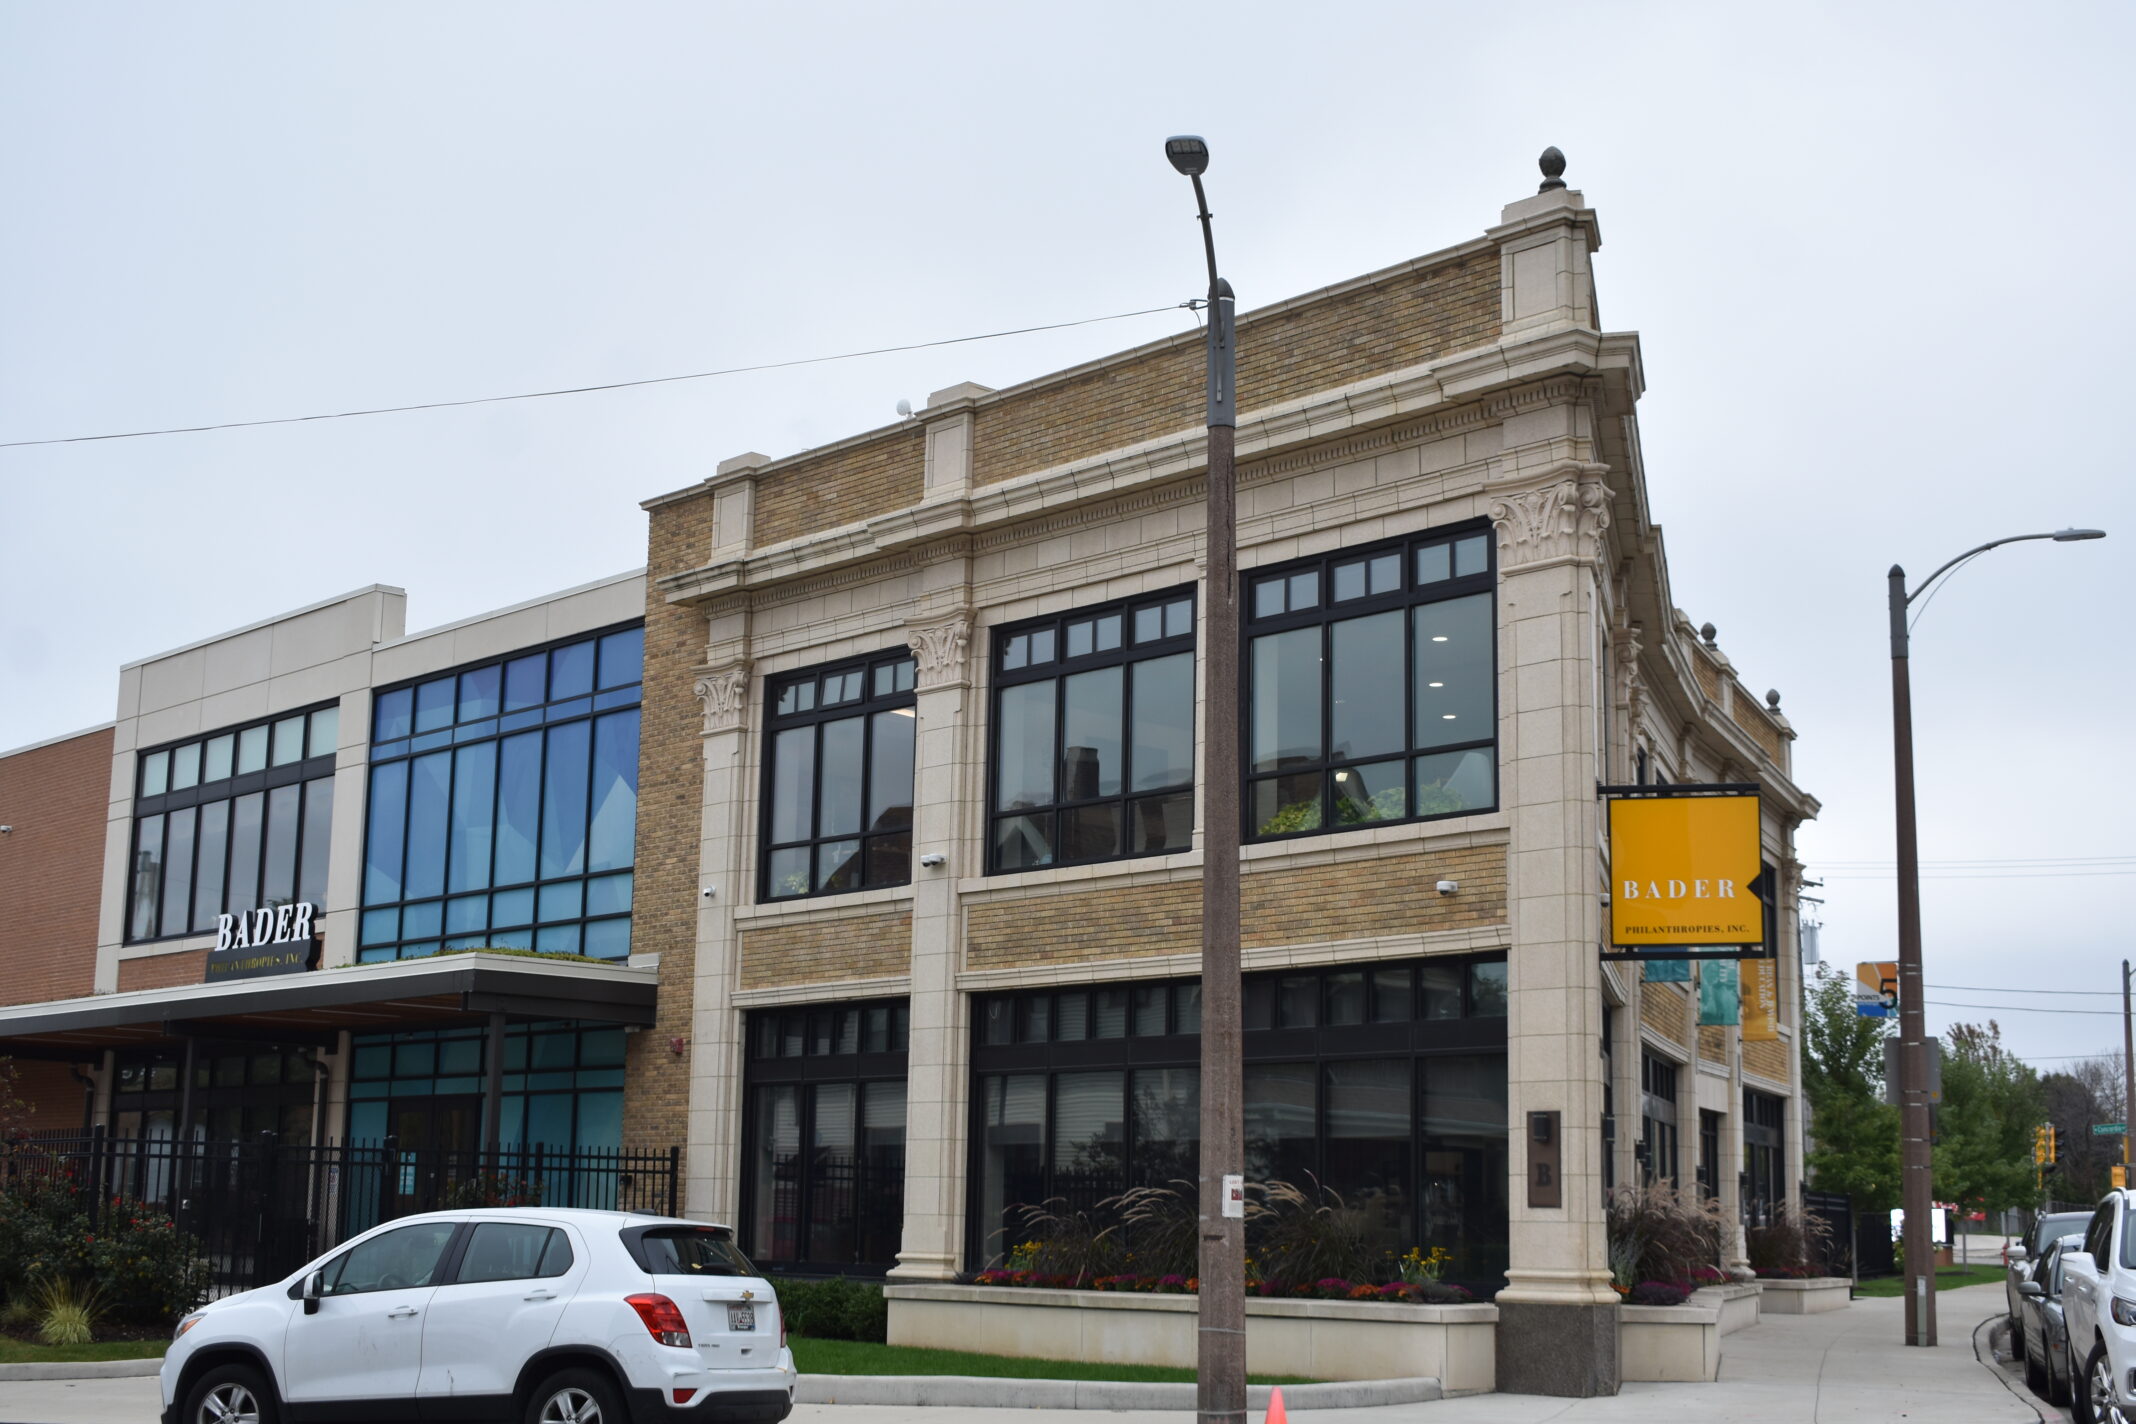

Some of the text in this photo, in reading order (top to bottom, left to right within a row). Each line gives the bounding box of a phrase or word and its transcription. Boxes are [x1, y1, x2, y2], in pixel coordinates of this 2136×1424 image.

[1624, 879, 1735, 899] BADER
[214, 902, 313, 951] BADER
[1625, 924, 1750, 934] PHILANTHROPIES, INC.
[1880, 978, 1897, 1009] 5
[1536, 1163, 1552, 1187] B
